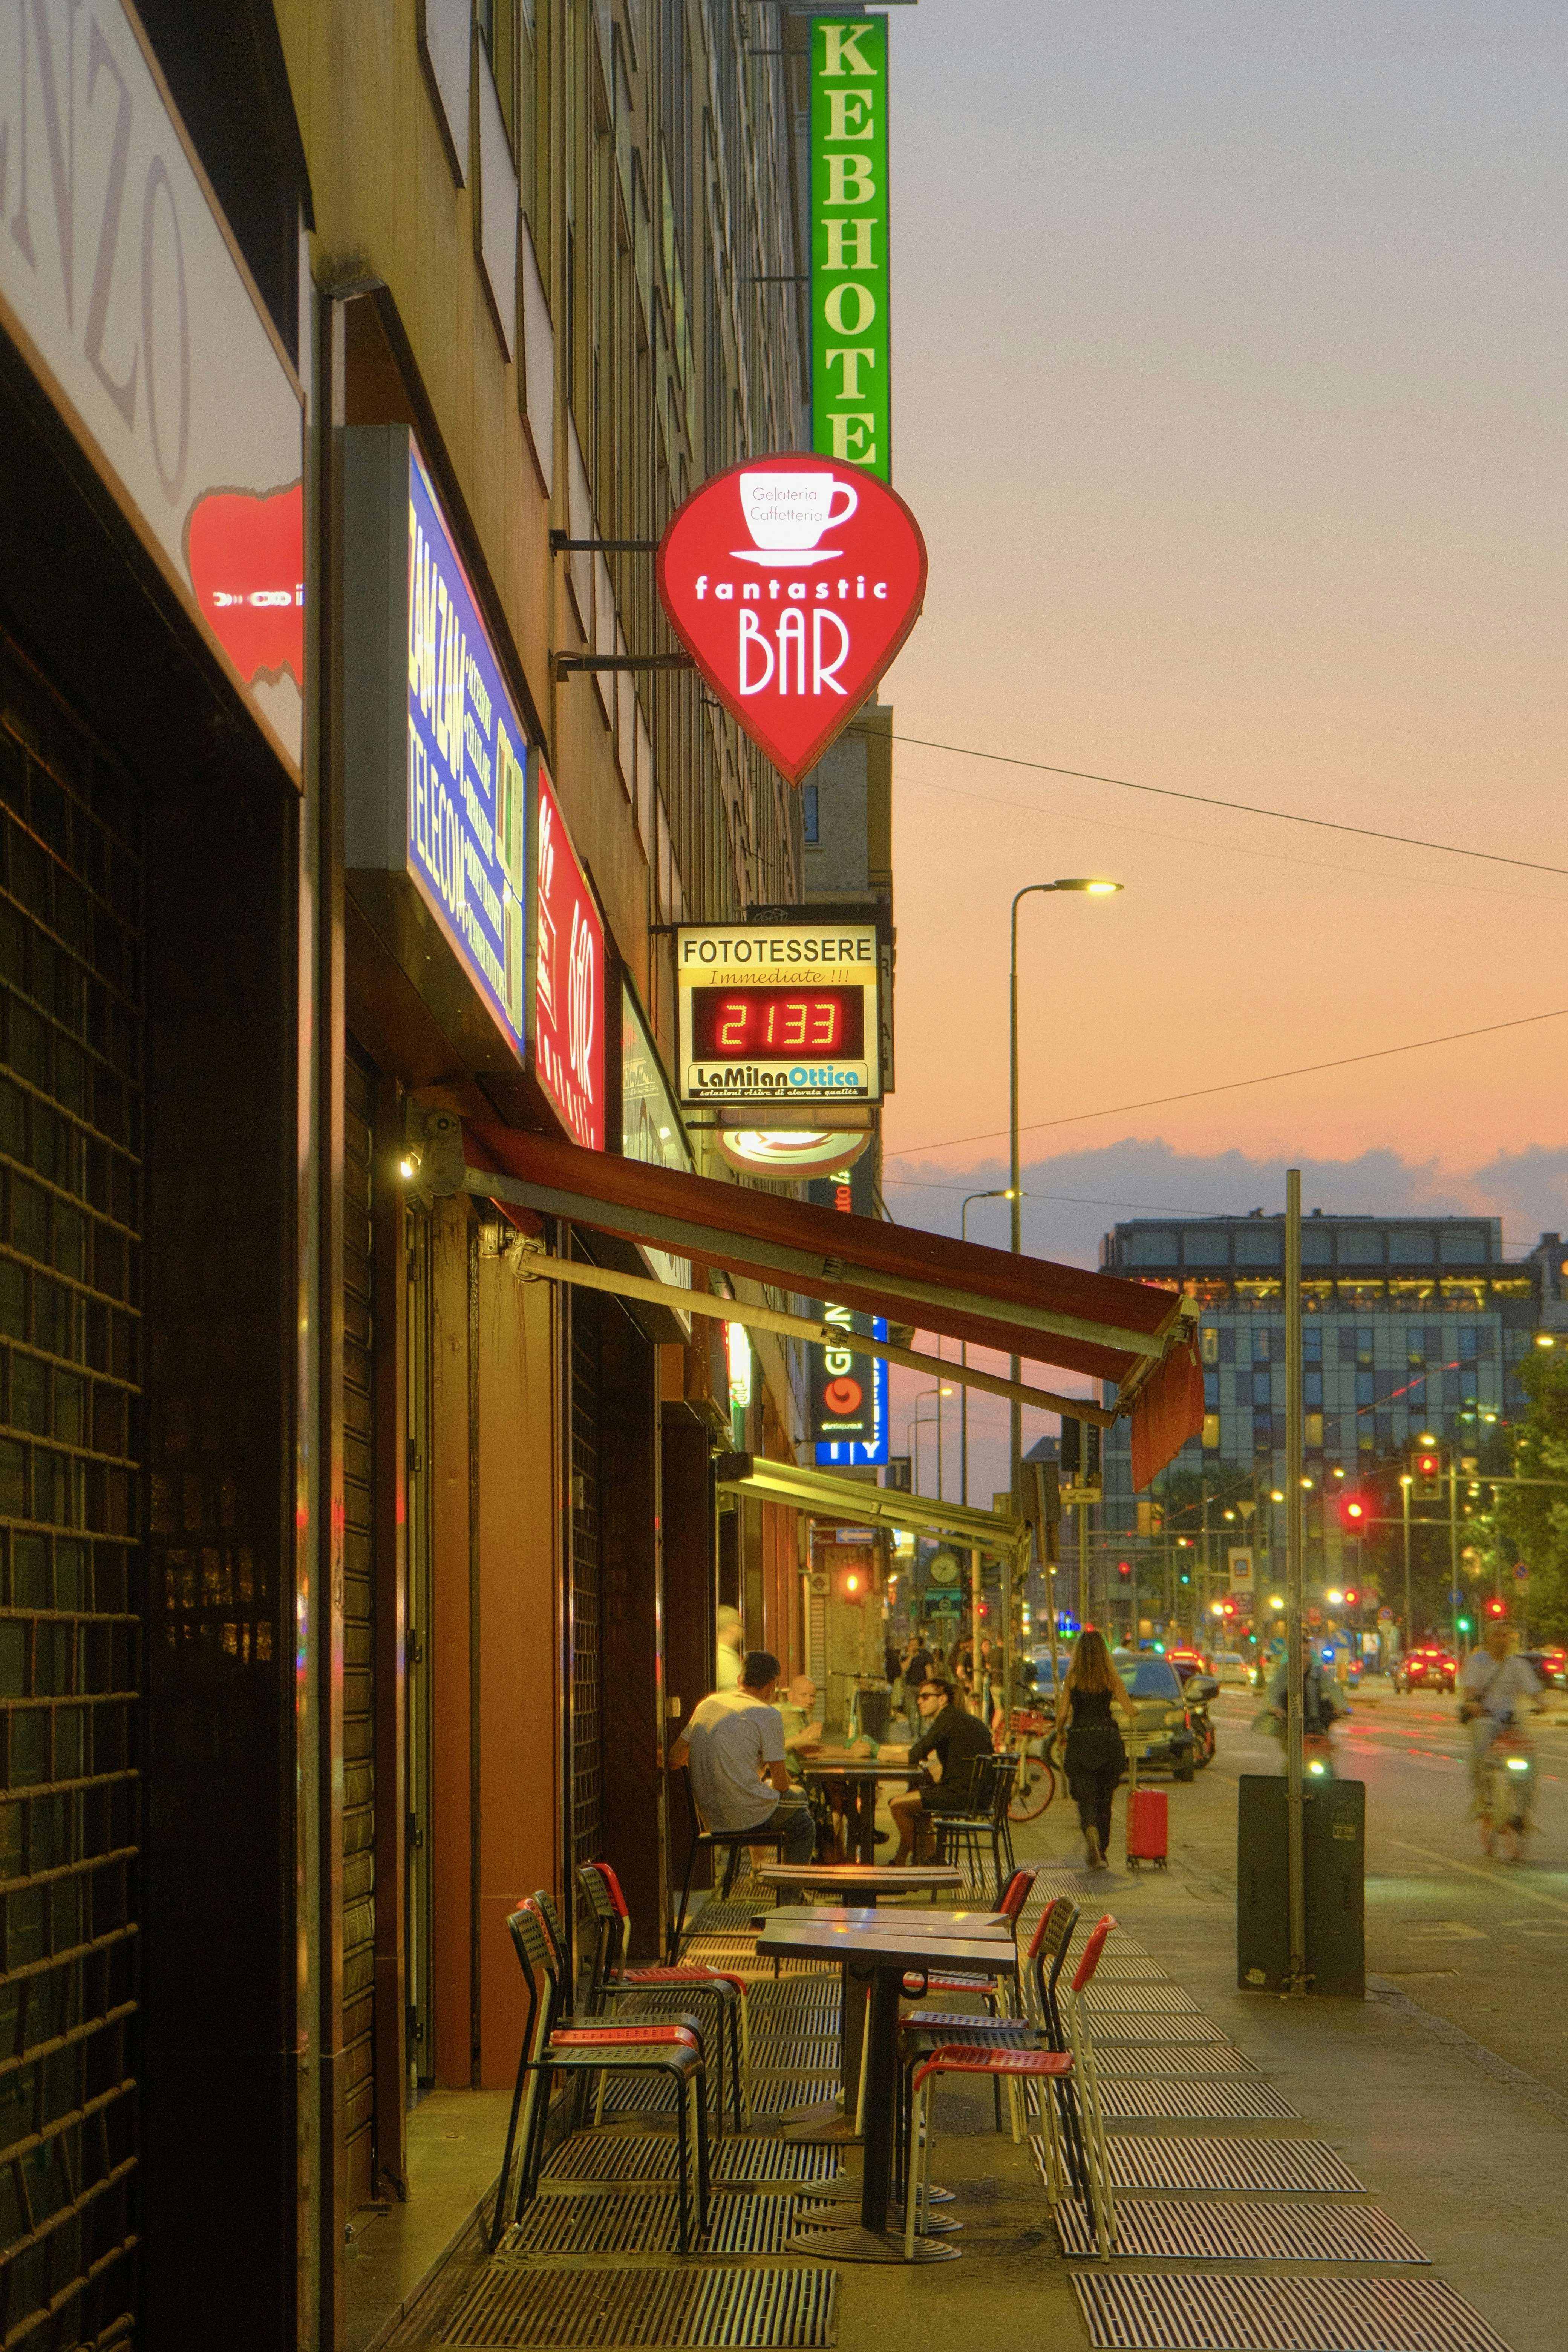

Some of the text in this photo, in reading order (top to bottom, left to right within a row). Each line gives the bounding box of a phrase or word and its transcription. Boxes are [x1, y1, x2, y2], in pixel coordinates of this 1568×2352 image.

[0, 0, 191, 506] NZO
[752, 487, 817, 501] Gelateria
[750, 505, 823, 522] Caffetteria
[695, 575, 887, 599] fantastic
[409, 498, 465, 796] ZAM ZAM
[739, 607, 849, 695] BAR
[409, 714, 465, 933] TELECOM
[684, 938, 871, 962] FOTOTESSERE
[709, 968, 849, 985] Immediate !!!
[568, 899, 594, 1104] BAR
[824, 1088, 859, 1096] qualità
